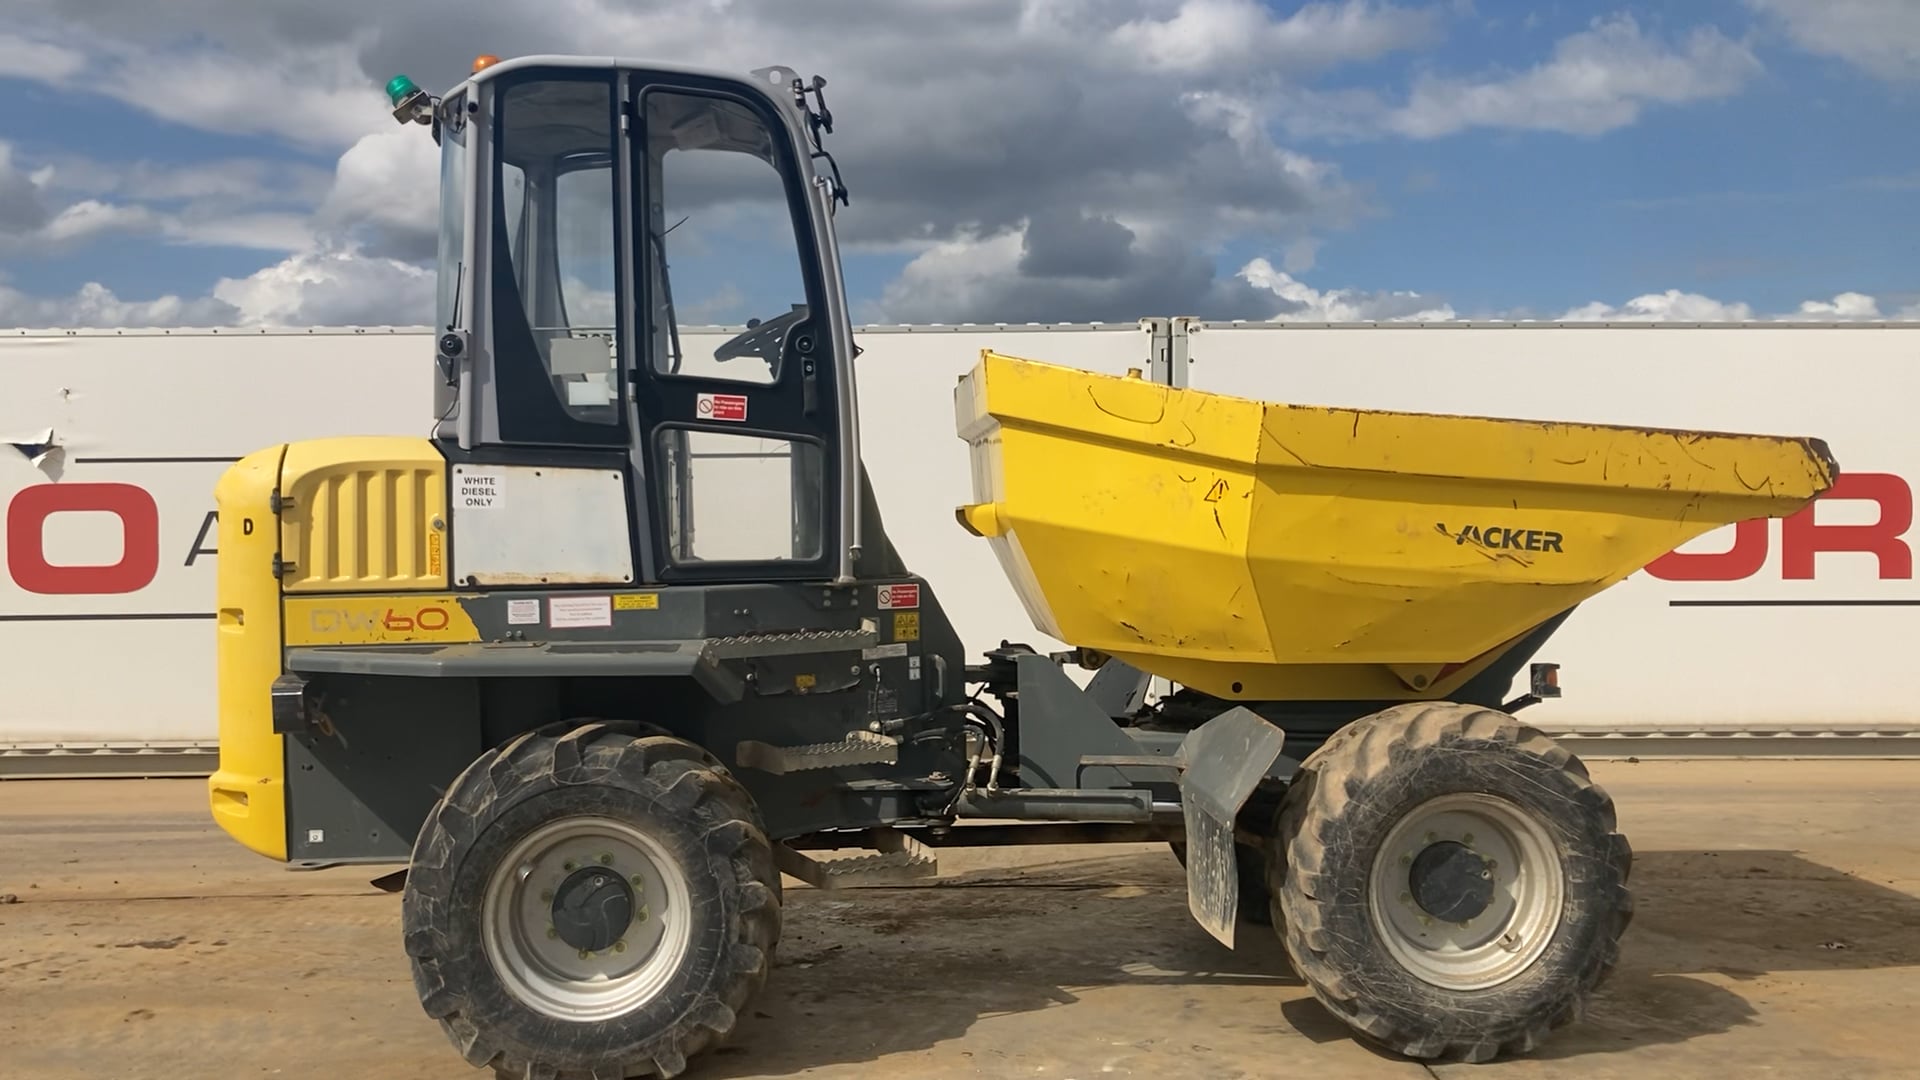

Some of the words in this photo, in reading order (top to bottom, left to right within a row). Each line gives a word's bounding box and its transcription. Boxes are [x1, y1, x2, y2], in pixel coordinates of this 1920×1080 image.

[464, 476, 496, 485] WHITE
[461, 487, 497, 496] DIESEL
[465, 497, 493, 506] ONLY
[243, 517, 254, 536] D
[7, 483, 159, 595] O
[310, 606, 450, 633] DW60
